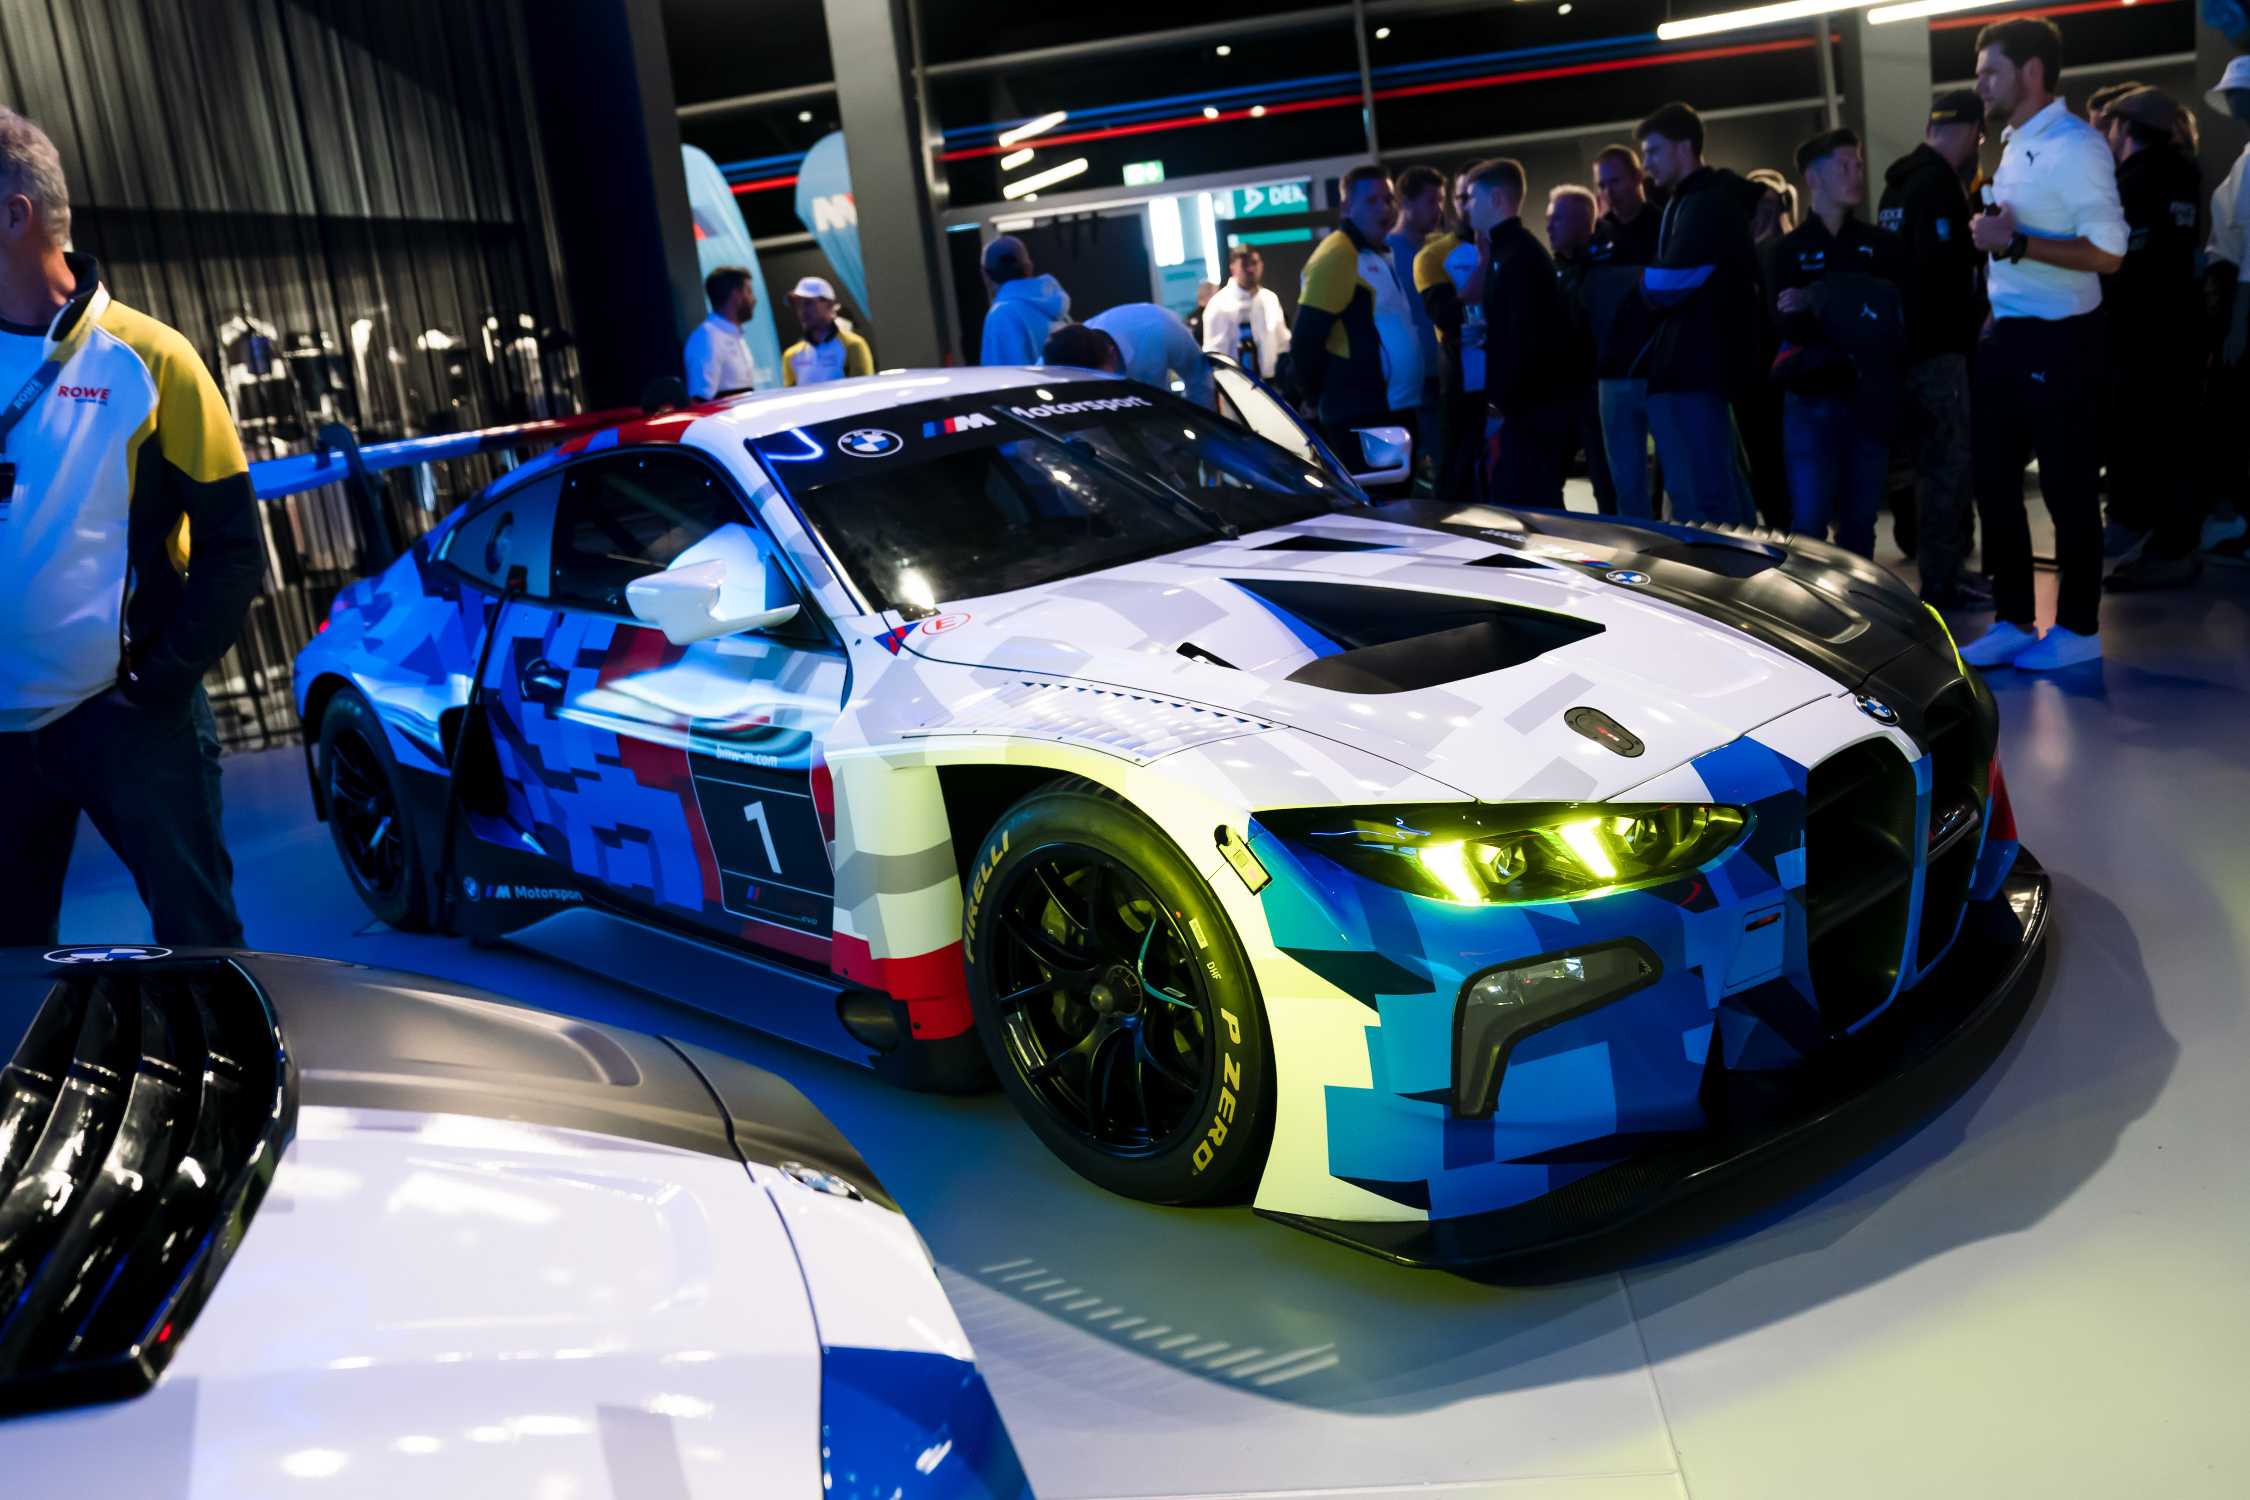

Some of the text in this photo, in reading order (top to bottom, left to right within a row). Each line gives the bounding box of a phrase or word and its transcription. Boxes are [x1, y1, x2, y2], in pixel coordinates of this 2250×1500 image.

[58, 386, 111, 400] ROWE
[716, 745, 778, 768] bmw-m.com
[743, 801, 783, 875] 1
[1206, 961, 1222, 980] DHF
[1192, 1007, 1242, 1171] P ZERO
